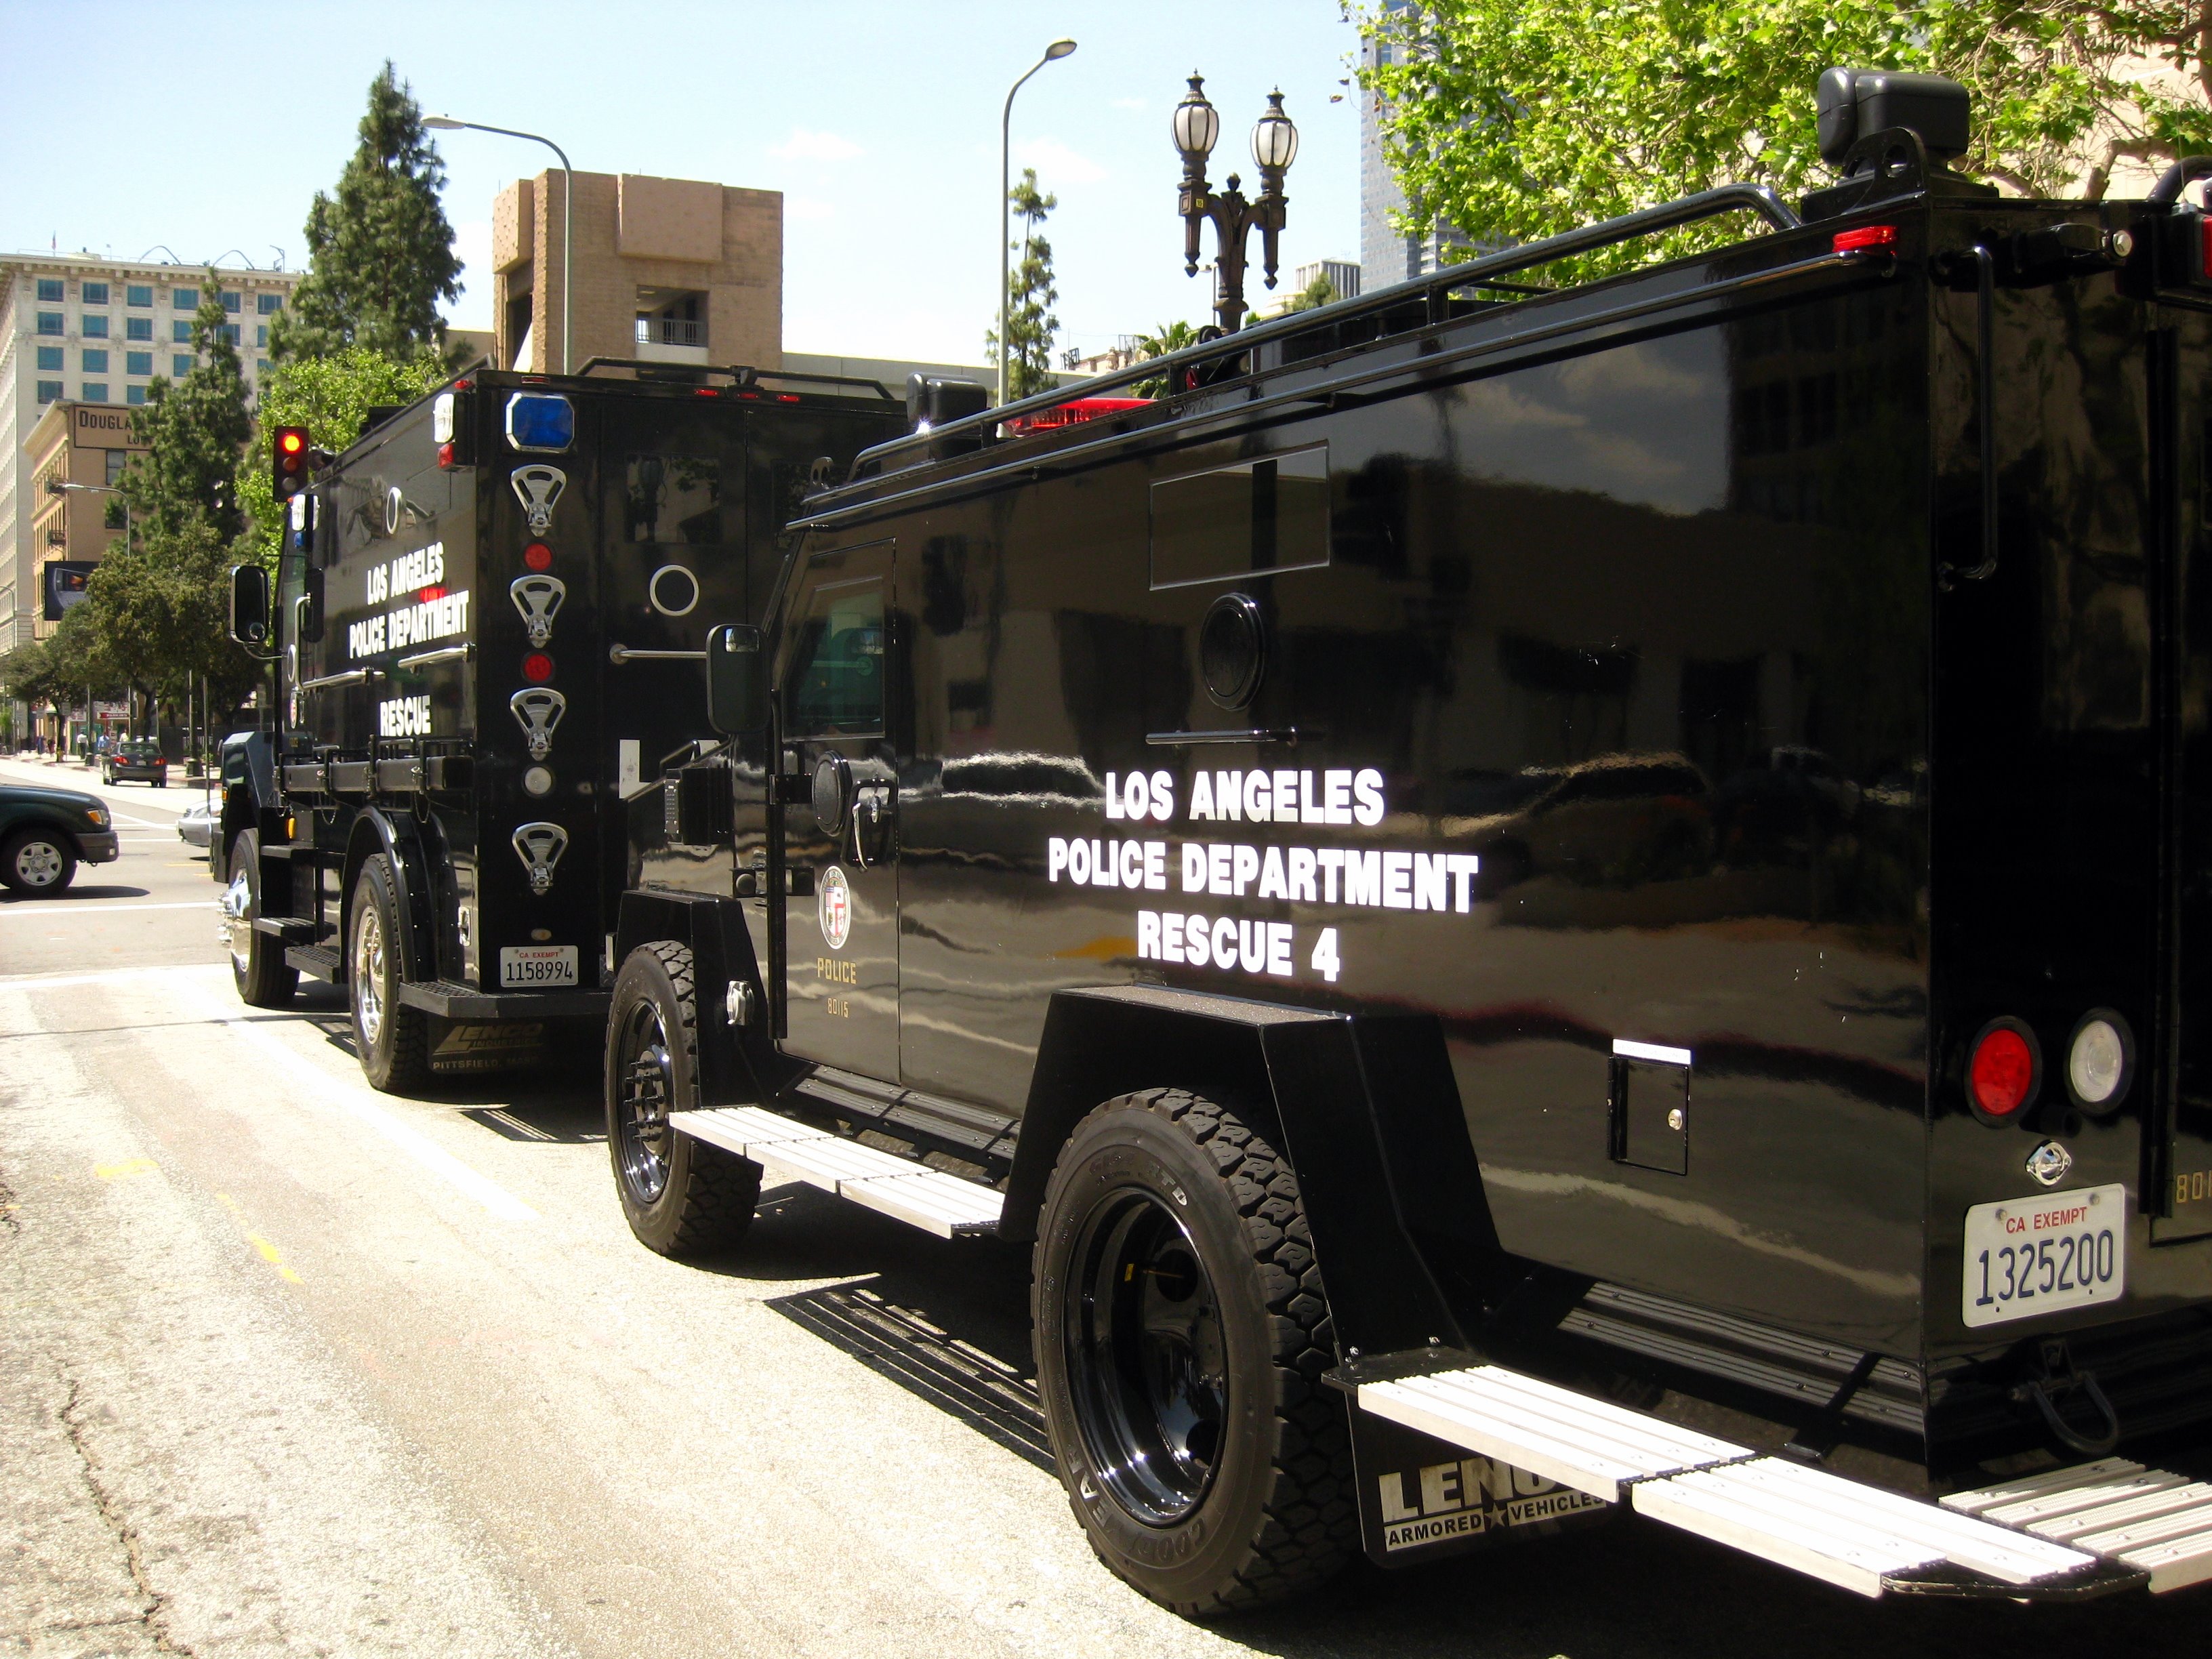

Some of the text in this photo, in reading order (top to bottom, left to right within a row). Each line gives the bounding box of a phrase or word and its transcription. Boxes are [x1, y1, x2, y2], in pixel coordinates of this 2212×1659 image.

[79, 410, 132, 430] DOUGLA
[367, 541, 445, 606] LOS ANGELES
[349, 590, 470, 659] POLICE DEPARTMENT
[380, 695, 432, 737] RESCUE
[1106, 769, 1385, 826] LOS ANGELES
[1048, 837, 1479, 914] POLICE DEPARTMENT
[1138, 910, 1340, 981] RESCUE 4
[506, 961, 573, 981] 1158994
[817, 957, 857, 985] POLICE
[827, 998, 848, 1018] 80115
[433, 1023, 544, 1053] LENCO
[2005, 1206, 2088, 1234] CA EXEMPT
[1975, 1229, 2114, 1307] 1325200
[1378, 1456, 1560, 1523] LEN
[1388, 1513, 1482, 1547] ARMORED
